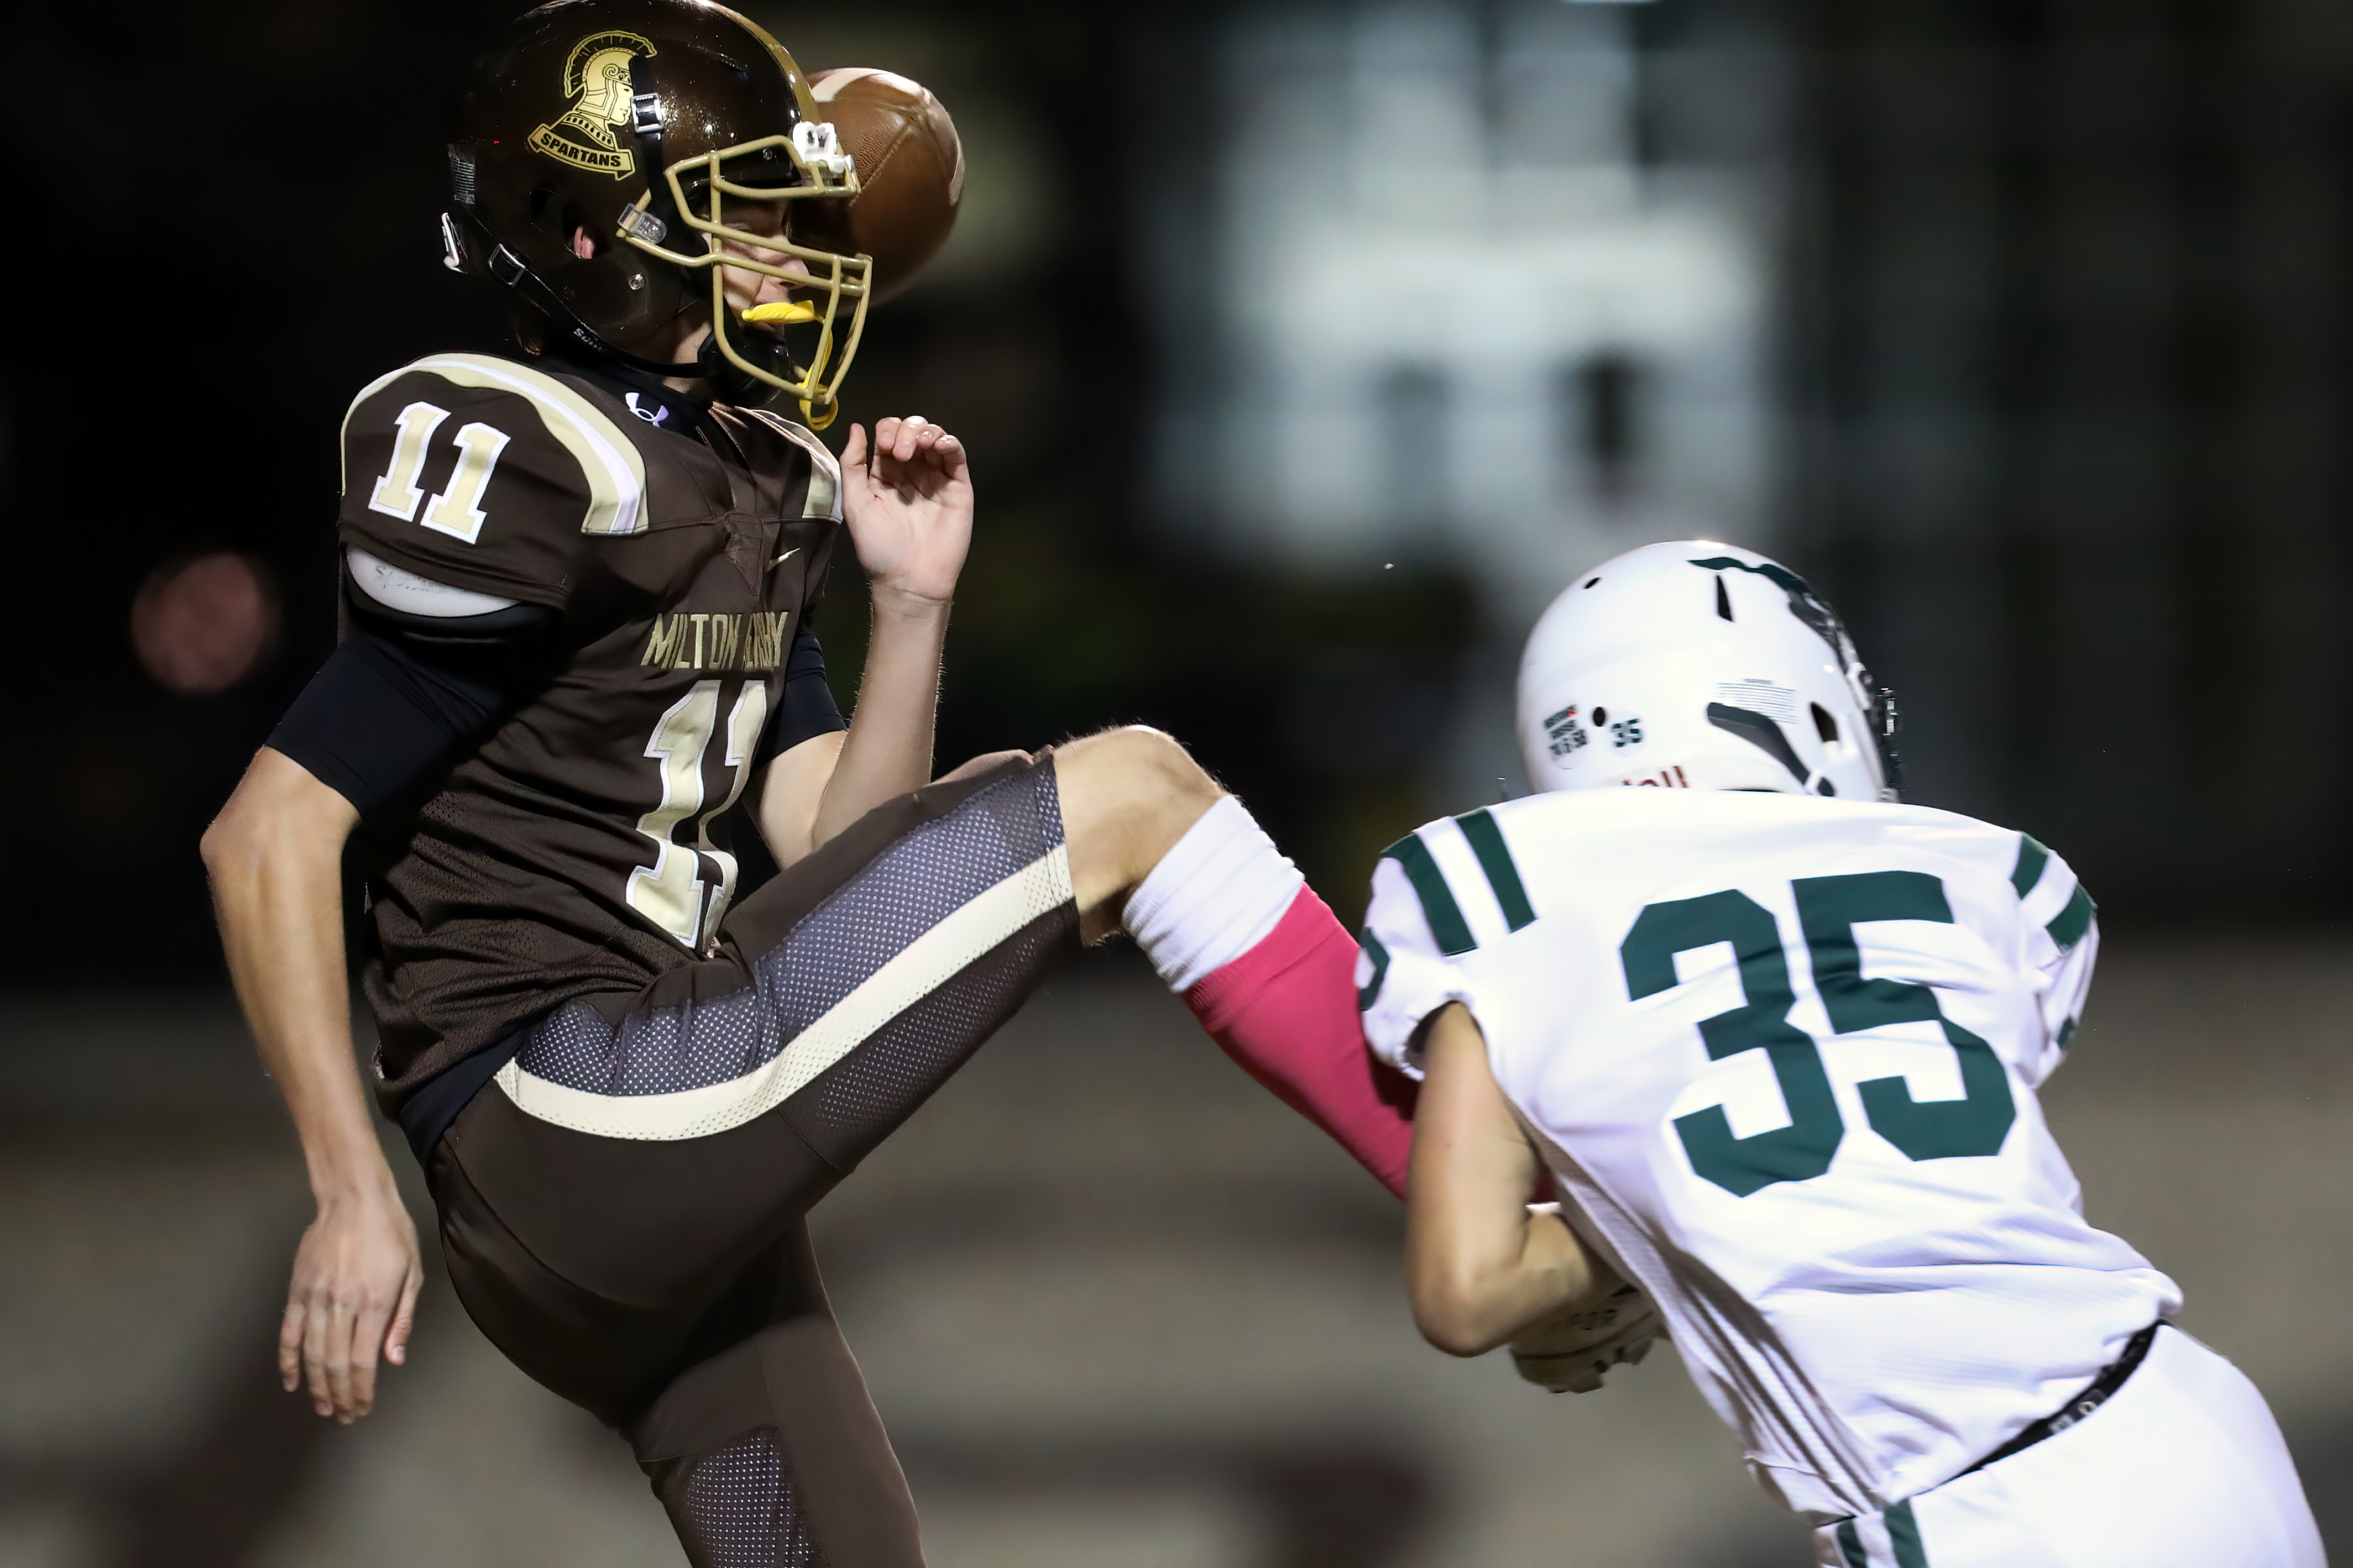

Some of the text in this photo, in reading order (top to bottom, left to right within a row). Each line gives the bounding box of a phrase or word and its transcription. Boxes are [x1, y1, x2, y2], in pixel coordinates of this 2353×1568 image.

[541, 133, 621, 167] SPARTANS
[368, 401, 511, 546] 11
[640, 612, 742, 669] MILTON
[1609, 718, 1643, 748] 35
[1620, 870, 2016, 1198] 35
